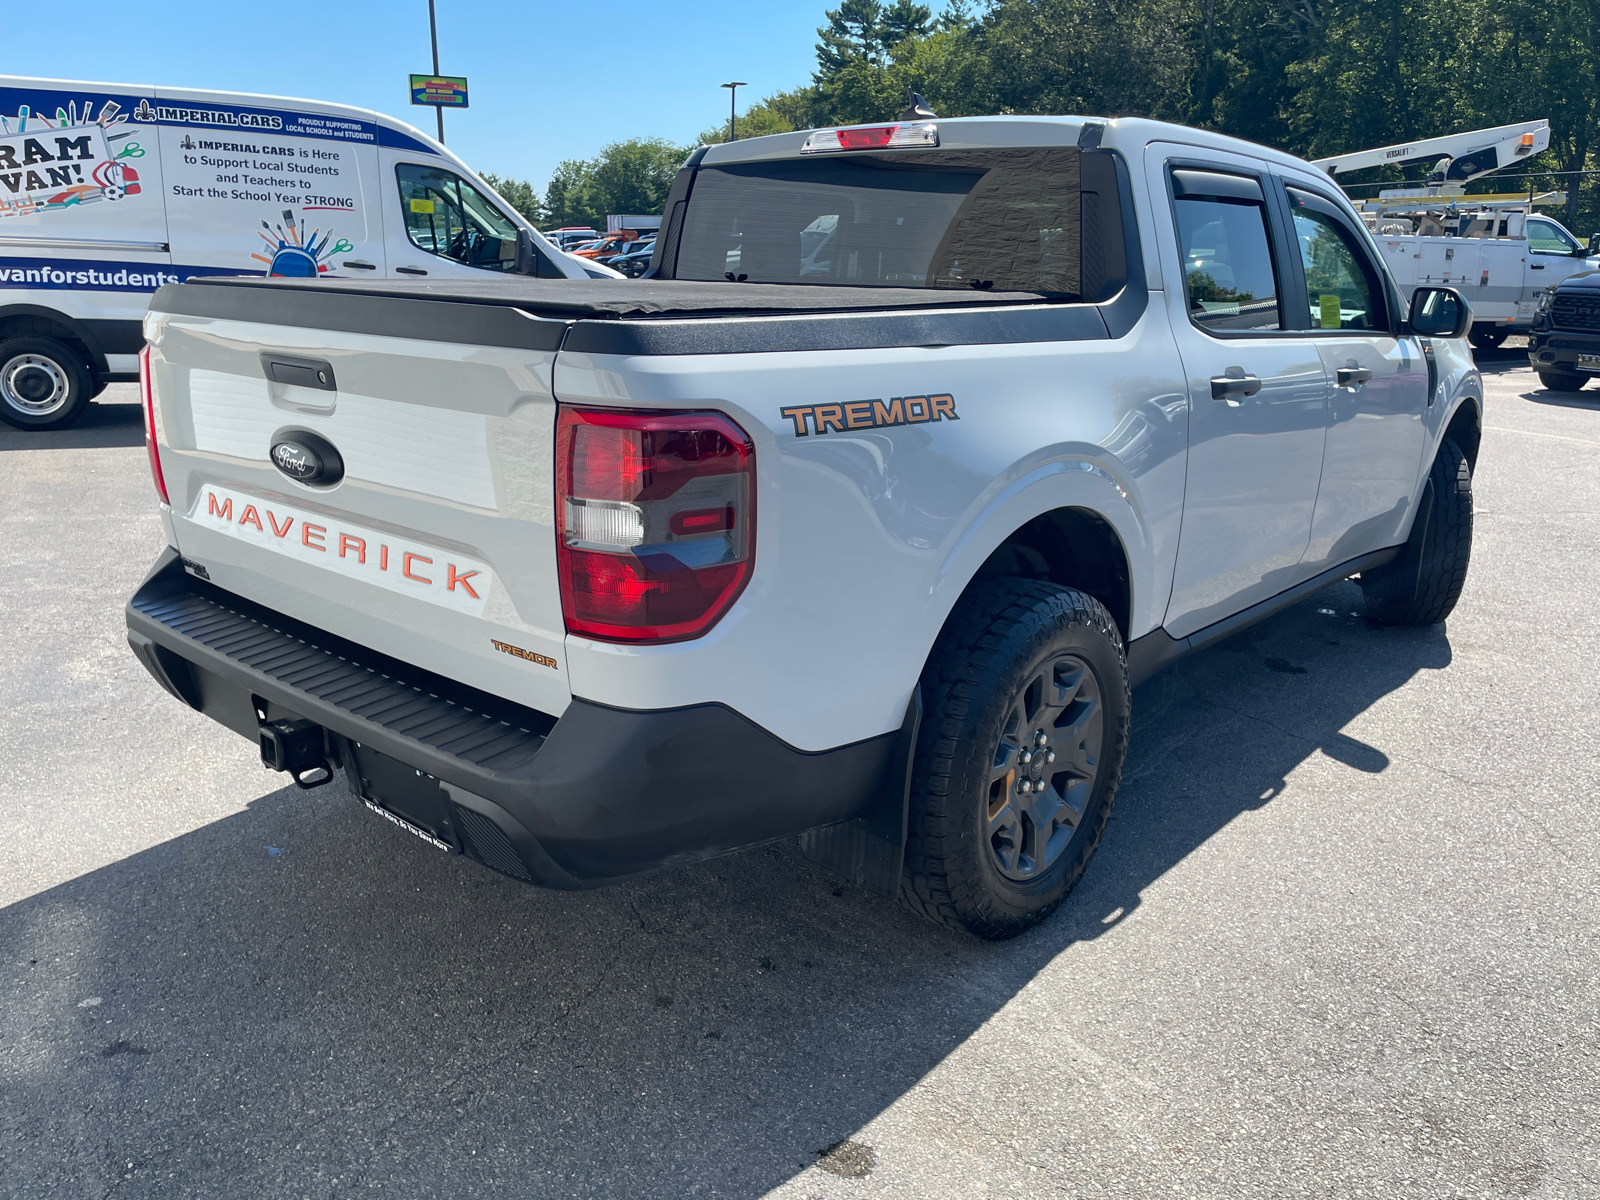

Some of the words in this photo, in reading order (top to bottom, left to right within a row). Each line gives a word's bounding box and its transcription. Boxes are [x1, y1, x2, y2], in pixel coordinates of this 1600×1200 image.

[158, 107, 237, 125] IMPERIAL
[239, 113, 282, 129] CARS
[298, 118, 325, 127] PROUDLY
[325, 120, 361, 131] SUPPORTING
[286, 124, 305, 133] LOCAL
[306, 127, 333, 136] SCHOOLS
[344, 130, 374, 140] STUDENTS
[199, 140, 260, 154] IMPERIAL
[262, 146, 295, 157] CARS
[299, 147, 309, 158] is
[312, 150, 340, 161] Here
[1386, 148, 1409, 159] VERSALIFT
[184, 154, 197, 165] to
[200, 155, 249, 170] Support
[253, 159, 284, 172] Local
[287, 163, 339, 176] Students
[0, 164, 84, 193] VAN!
[216, 173, 239, 184] and
[242, 174, 296, 189] Teachers
[299, 179, 312, 189] to
[173, 185, 204, 198] Start
[207, 187, 228, 199] the
[231, 189, 271, 202] School
[274, 192, 302, 204] Year
[304, 196, 353, 208] STRONG
[780, 393, 960, 437] TREMOR
[279, 445, 306, 472] Ford
[208, 491, 482, 600] MAVERICK
[491, 639, 558, 670] TREMOR
